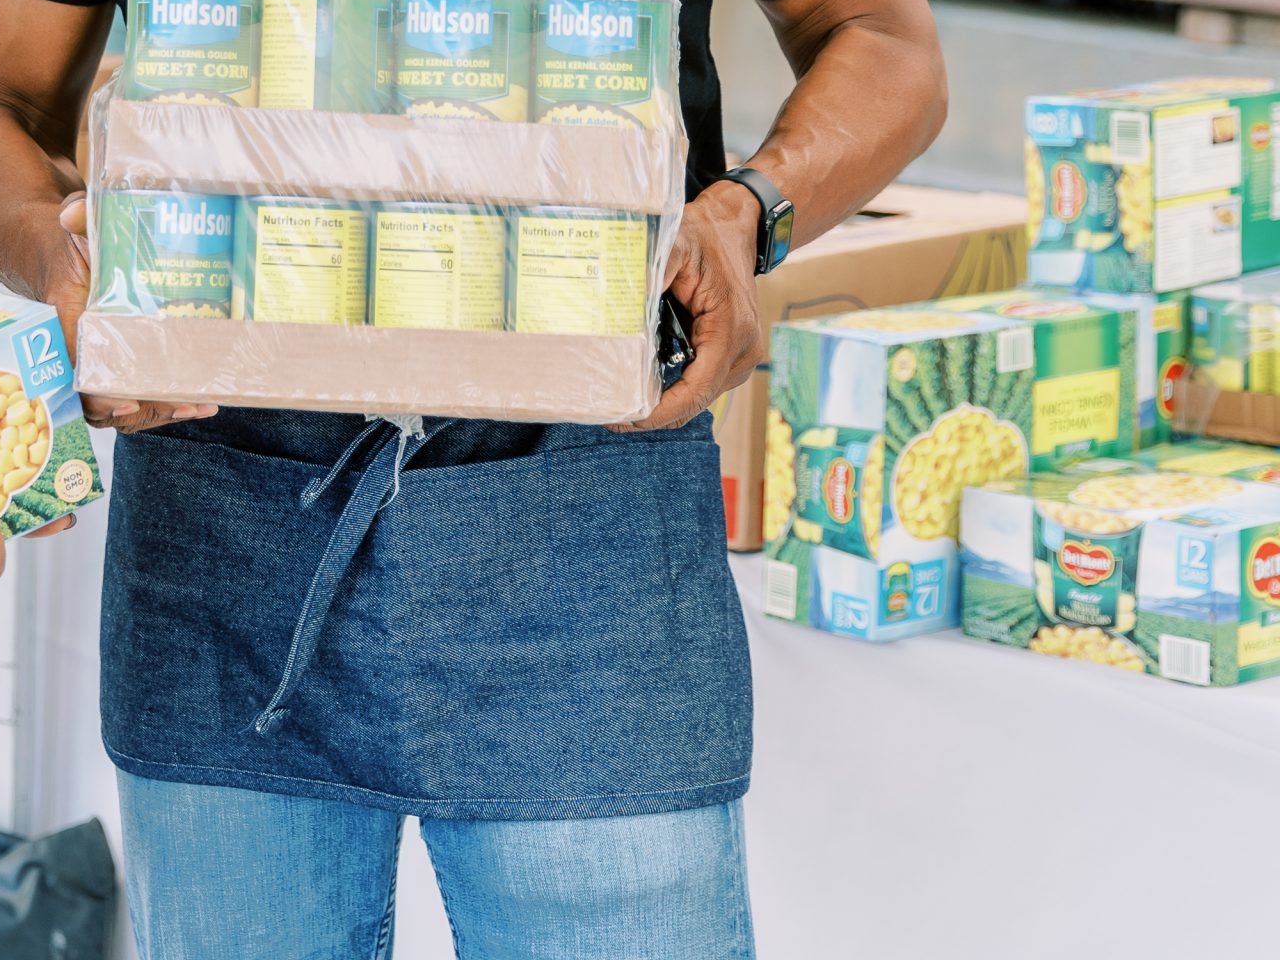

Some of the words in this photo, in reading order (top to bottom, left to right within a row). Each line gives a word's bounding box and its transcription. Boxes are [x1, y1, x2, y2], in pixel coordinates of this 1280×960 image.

[407, 0, 490, 35] Hudson
[549, 4, 633, 39] Hudson
[136, 61, 197, 79] SWEET
[203, 64, 249, 80] CORN
[456, 59, 490, 69] GOLDEN
[599, 61, 633, 72] GOLDEN
[399, 71, 445, 86] SWEET
[451, 72, 505, 88] CORN
[537, 74, 589, 89] SWEET
[595, 75, 648, 91] CORN
[263, 215, 311, 227] Nutrition
[314, 217, 343, 228] Facts
[380, 221, 418, 232] Nutrition
[422, 222, 455, 233] Facts
[522, 226, 565, 238] Nutrition
[568, 228, 600, 239] Facts
[331, 254, 342, 265] 60
[440, 259, 453, 270] 60
[586, 265, 600, 276] 60
[137, 270, 205, 288] SWEET
[21, 327, 59, 369] 12
[30, 360, 65, 387] CANS
[63, 471, 83, 484] NON
[65, 478, 85, 492] GMO
[1182, 540, 1209, 570] 12
